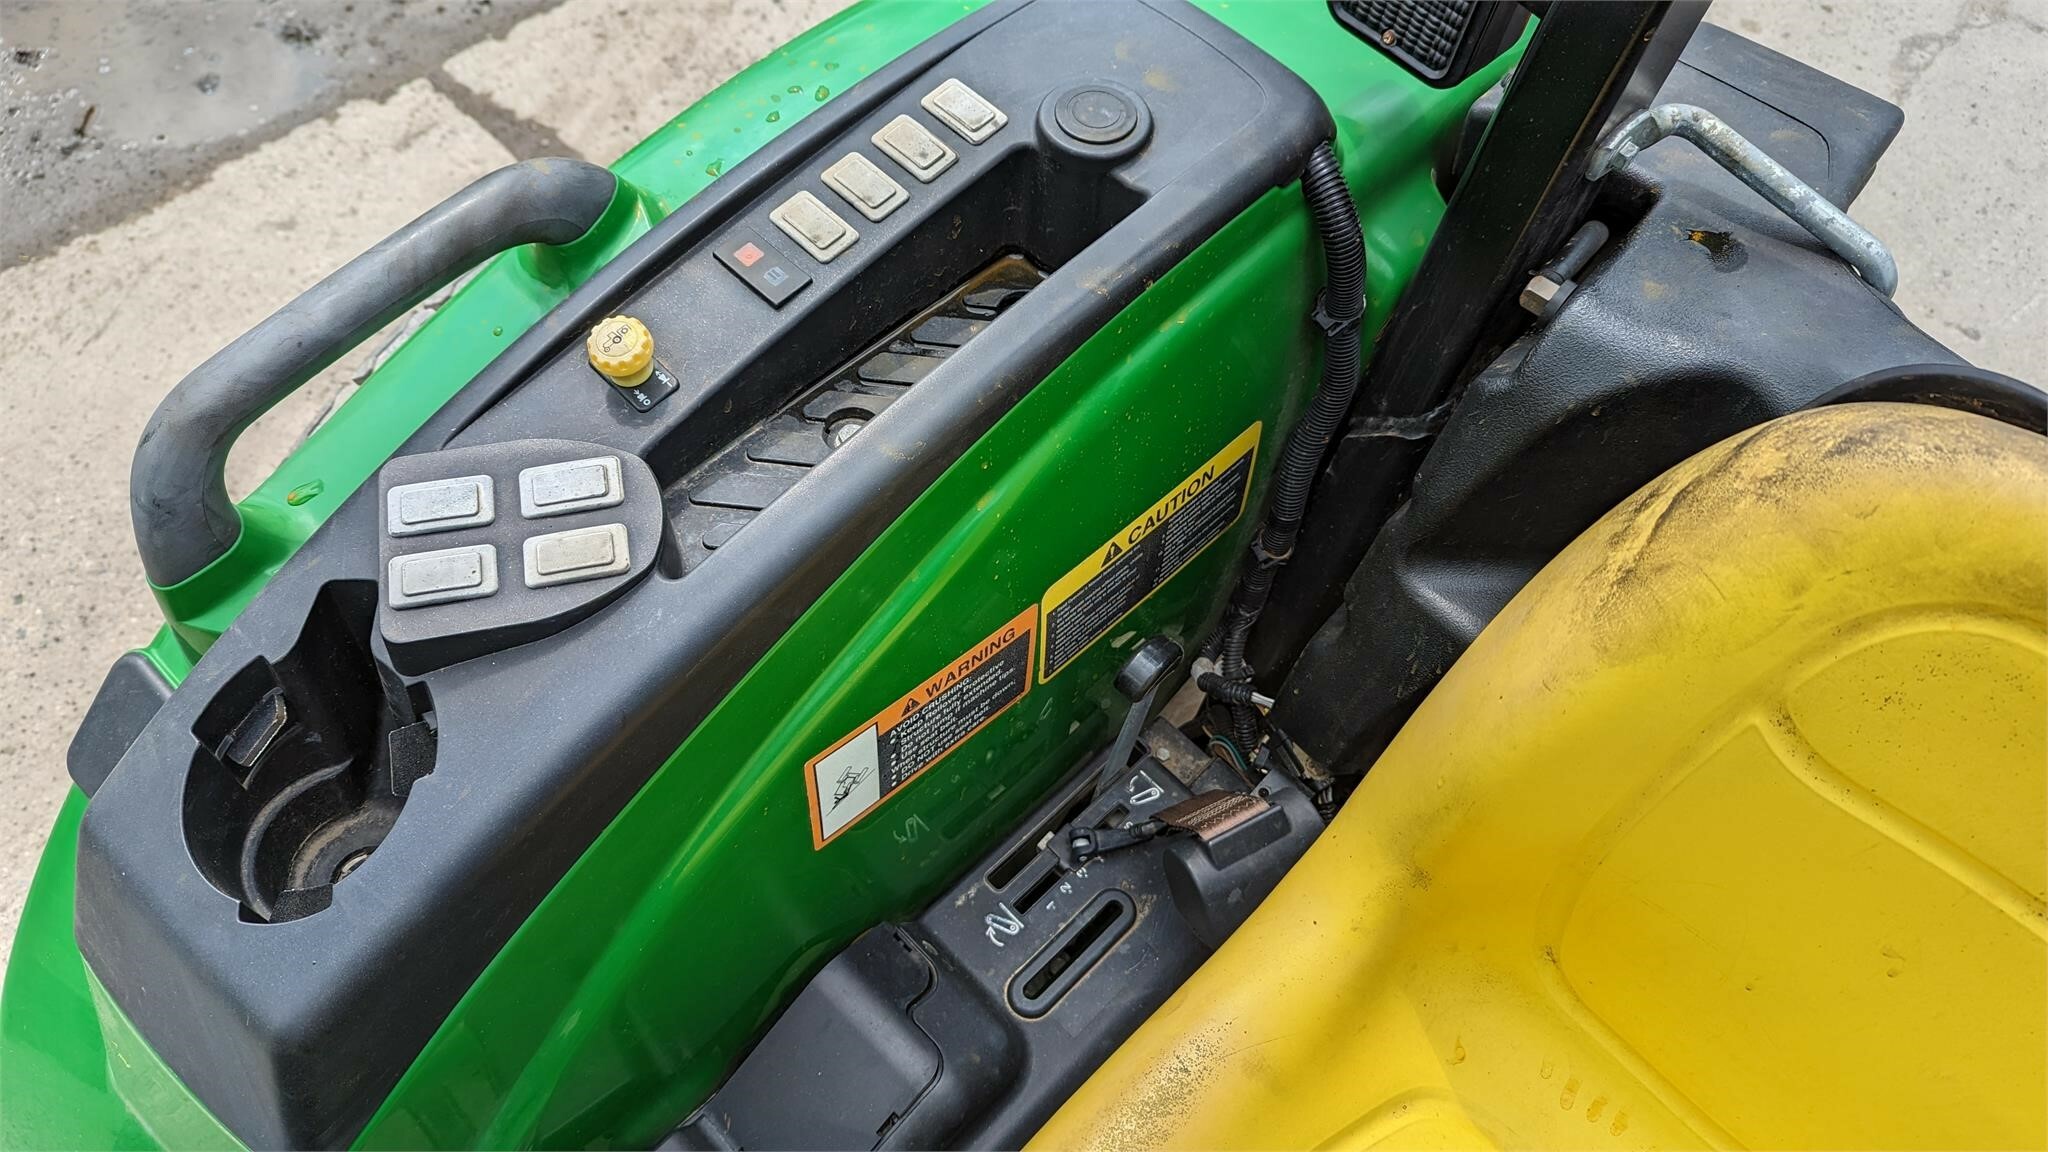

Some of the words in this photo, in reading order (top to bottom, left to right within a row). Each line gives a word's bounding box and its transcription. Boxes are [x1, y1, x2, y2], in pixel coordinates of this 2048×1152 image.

[1128, 466, 1215, 545] CAUTION
[925, 627, 1015, 698] WARNING
[889, 711, 919, 738] AVOID
[921, 676, 970, 715] CRUSHING:
[900, 718, 923, 737] Keep
[925, 691, 960, 720] Rollover
[963, 660, 1004, 692] Protective
[900, 713, 941, 746] Structure
[943, 699, 961, 714] fully
[963, 670, 1001, 700] extended.
[901, 741, 913, 753] Do
[915, 727, 929, 742] not
[931, 712, 952, 730] jump
[955, 704, 960, 713] if
[963, 680, 996, 708] machine
[891, 753, 916, 774] When
[918, 724, 955, 755] structure
[958, 706, 978, 725] must
[980, 699, 990, 709] be
[901, 745, 917, 760] Use
[920, 729, 937, 746] seat
[901, 759, 914, 774] DO
[917, 744, 934, 762] NOT
[937, 734, 952, 747] use
[955, 718, 971, 734] seat
[901, 761, 923, 781] Drive
[925, 745, 942, 763] with
[944, 731, 965, 749] extra
[1060, 882, 1072, 894] 2
